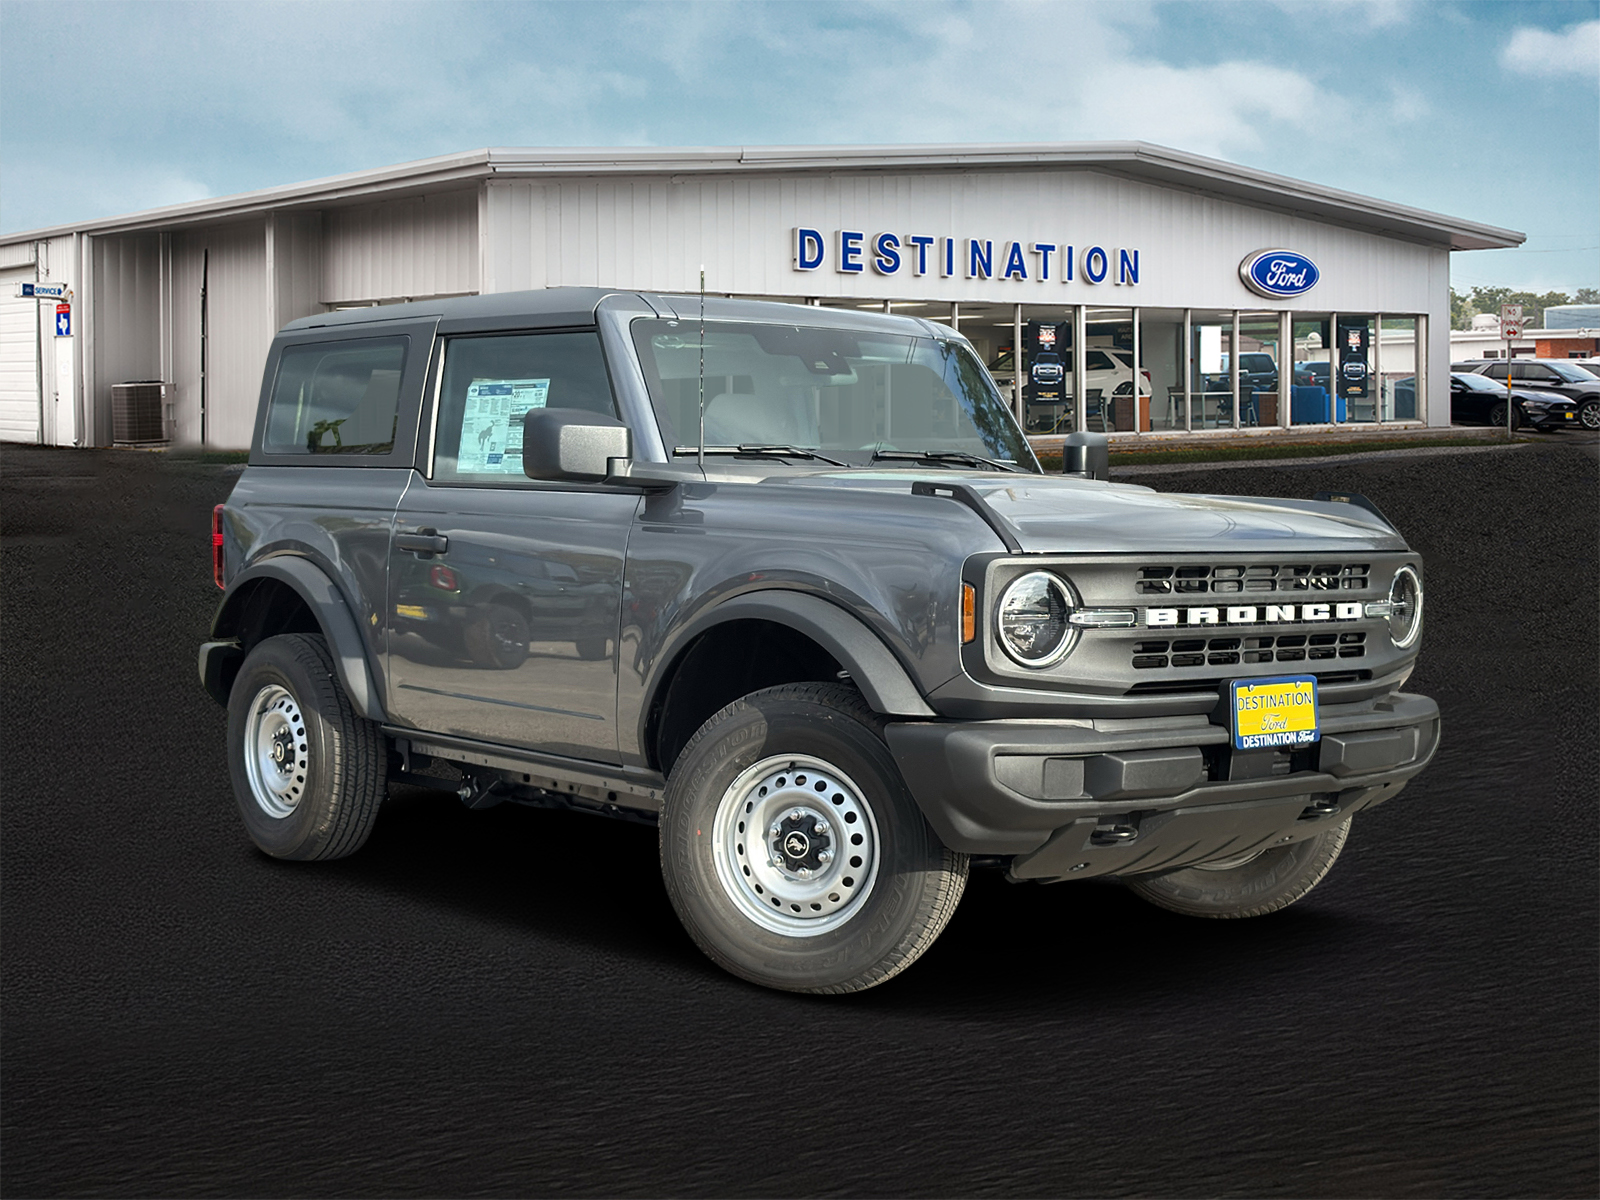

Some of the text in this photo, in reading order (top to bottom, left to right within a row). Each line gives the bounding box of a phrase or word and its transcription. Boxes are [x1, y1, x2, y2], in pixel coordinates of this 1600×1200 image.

[792, 227, 1140, 286] DESTINATION
[1266, 259, 1307, 287] Ford
[35, 287, 57, 295] SERVICE
[1146, 602, 1363, 626] BRONCO
[1237, 692, 1312, 711] DESTINATION
[1261, 713, 1288, 731] Ford
[1243, 730, 1315, 748] DESTINATION Ford
